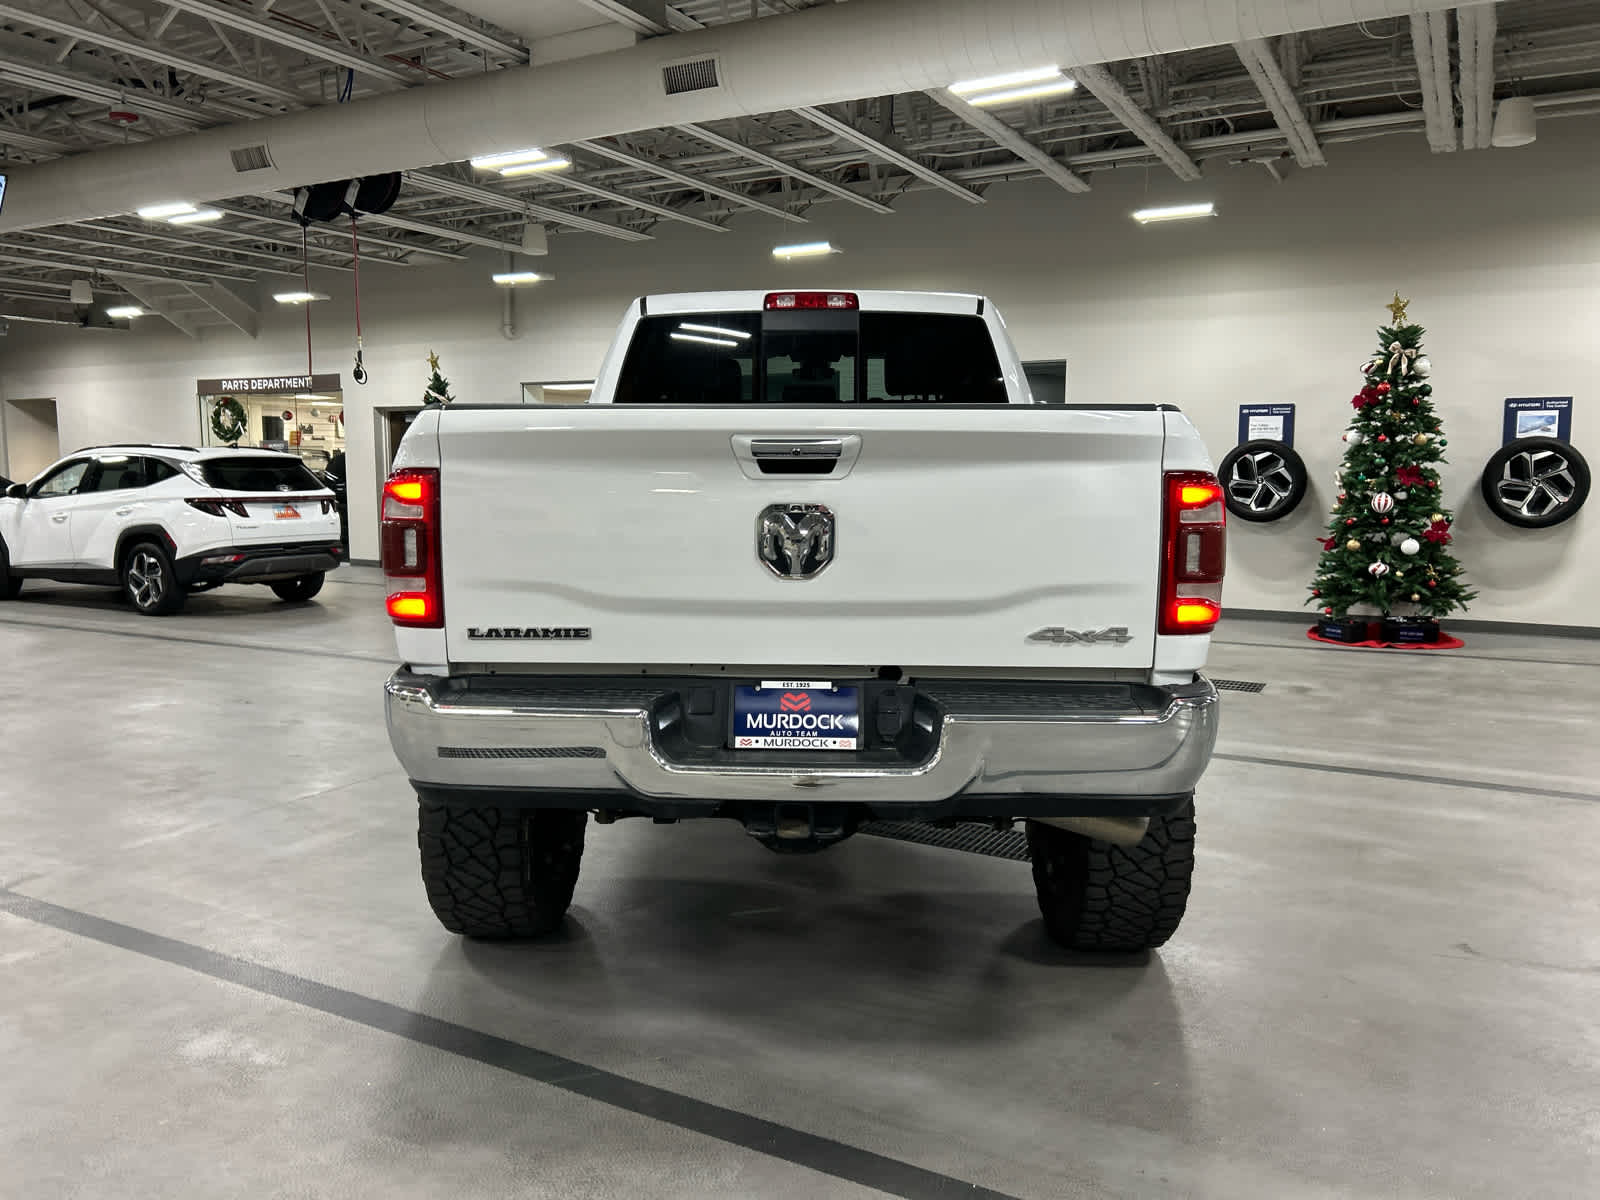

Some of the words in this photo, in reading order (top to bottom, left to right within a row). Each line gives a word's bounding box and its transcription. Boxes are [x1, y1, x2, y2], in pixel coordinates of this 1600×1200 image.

[222, 380, 249, 391] PARTS
[251, 377, 311, 390] DEPARTMENT
[466, 627, 593, 641] LARAMIE
[746, 713, 844, 729] MURDOCK
[763, 738, 829, 748] MURDOCK
